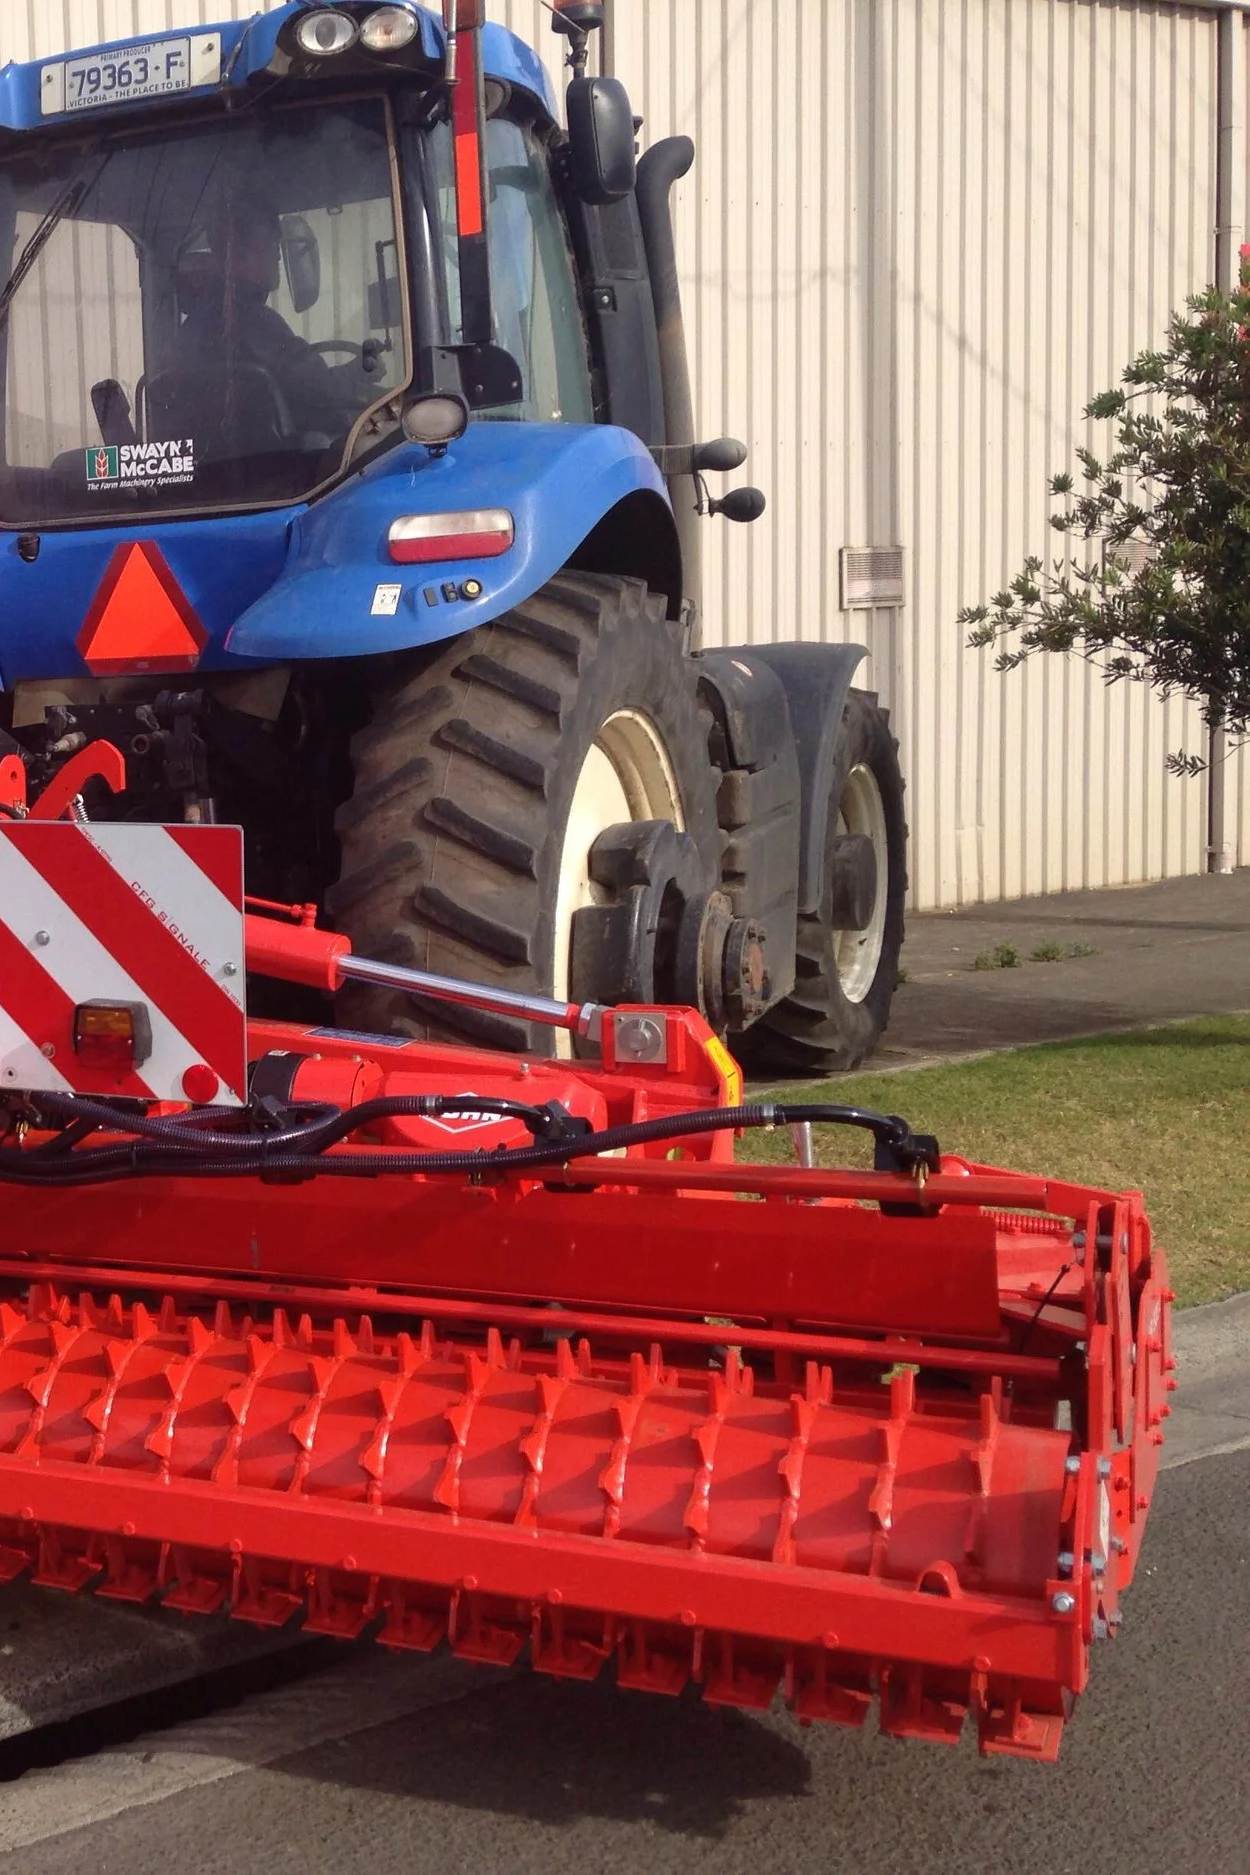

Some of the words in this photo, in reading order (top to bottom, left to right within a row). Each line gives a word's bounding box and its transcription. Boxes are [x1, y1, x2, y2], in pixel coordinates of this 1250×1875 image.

[100, 51, 122, 62] PRIMARY
[123, 46, 151, 58] PRODUCER
[71, 57, 149, 97] 79363
[69, 94, 108, 108] VICTORIA
[115, 90, 130, 98] THE
[132, 84, 159, 95] PLACE
[161, 82, 173, 91] TO
[120, 456, 194, 478] McCABE
[87, 483, 99, 491] The
[100, 482, 119, 490] Farm
[119, 478, 156, 489] Machinery
[157, 474, 194, 486] Specialists
[131, 881, 156, 909] CFG
[157, 911, 210, 970] SIGNALE
